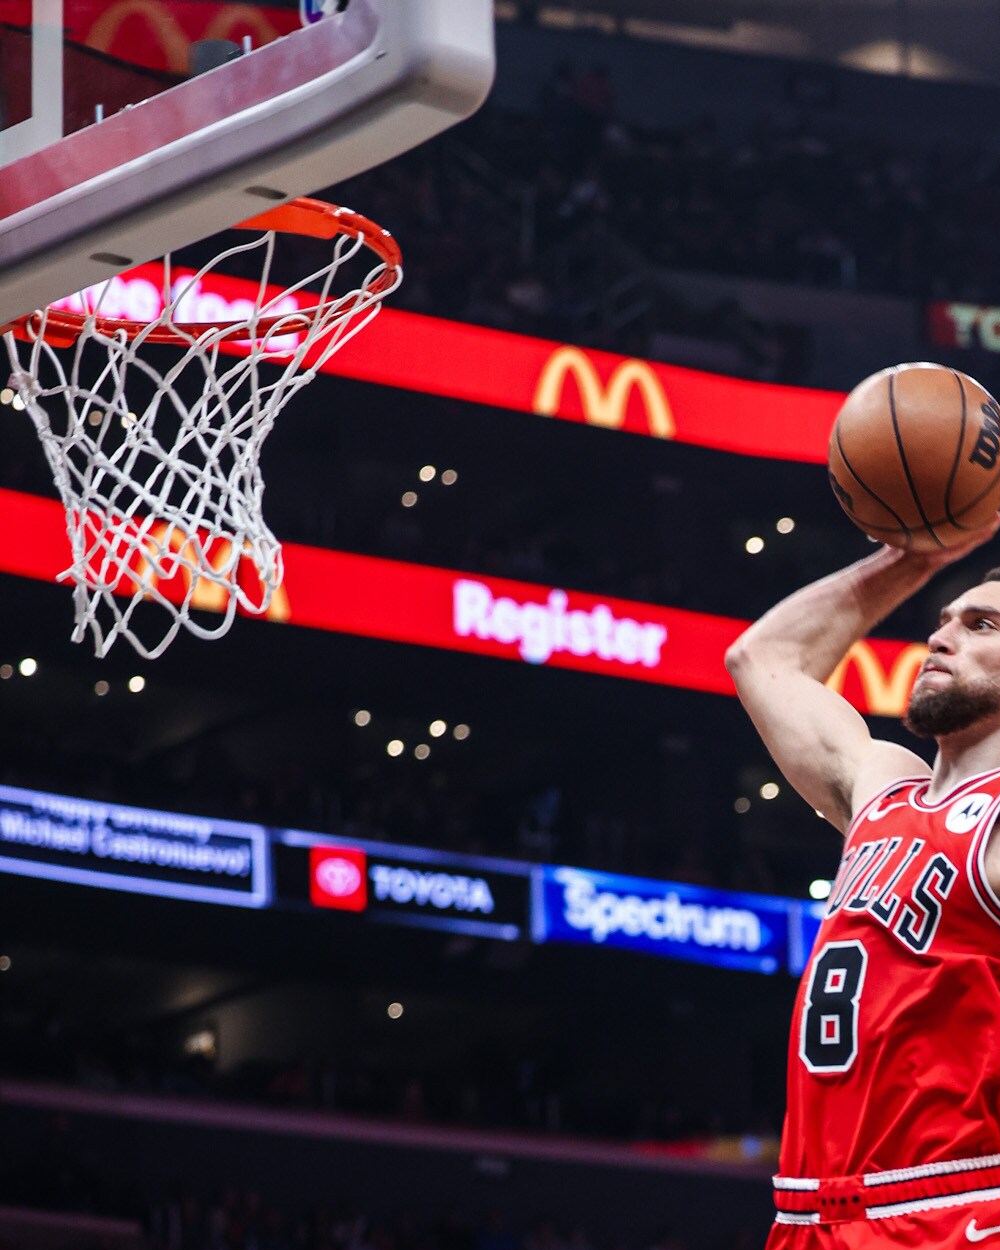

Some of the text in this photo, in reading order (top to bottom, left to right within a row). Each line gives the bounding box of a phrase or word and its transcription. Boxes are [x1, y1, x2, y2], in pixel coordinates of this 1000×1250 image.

[453, 579, 668, 668] Register
[369, 864, 494, 914] TOYOTA
[560, 874, 763, 952] Spectrum
[825, 836, 959, 955] ULLS
[799, 938, 869, 1074] 8
